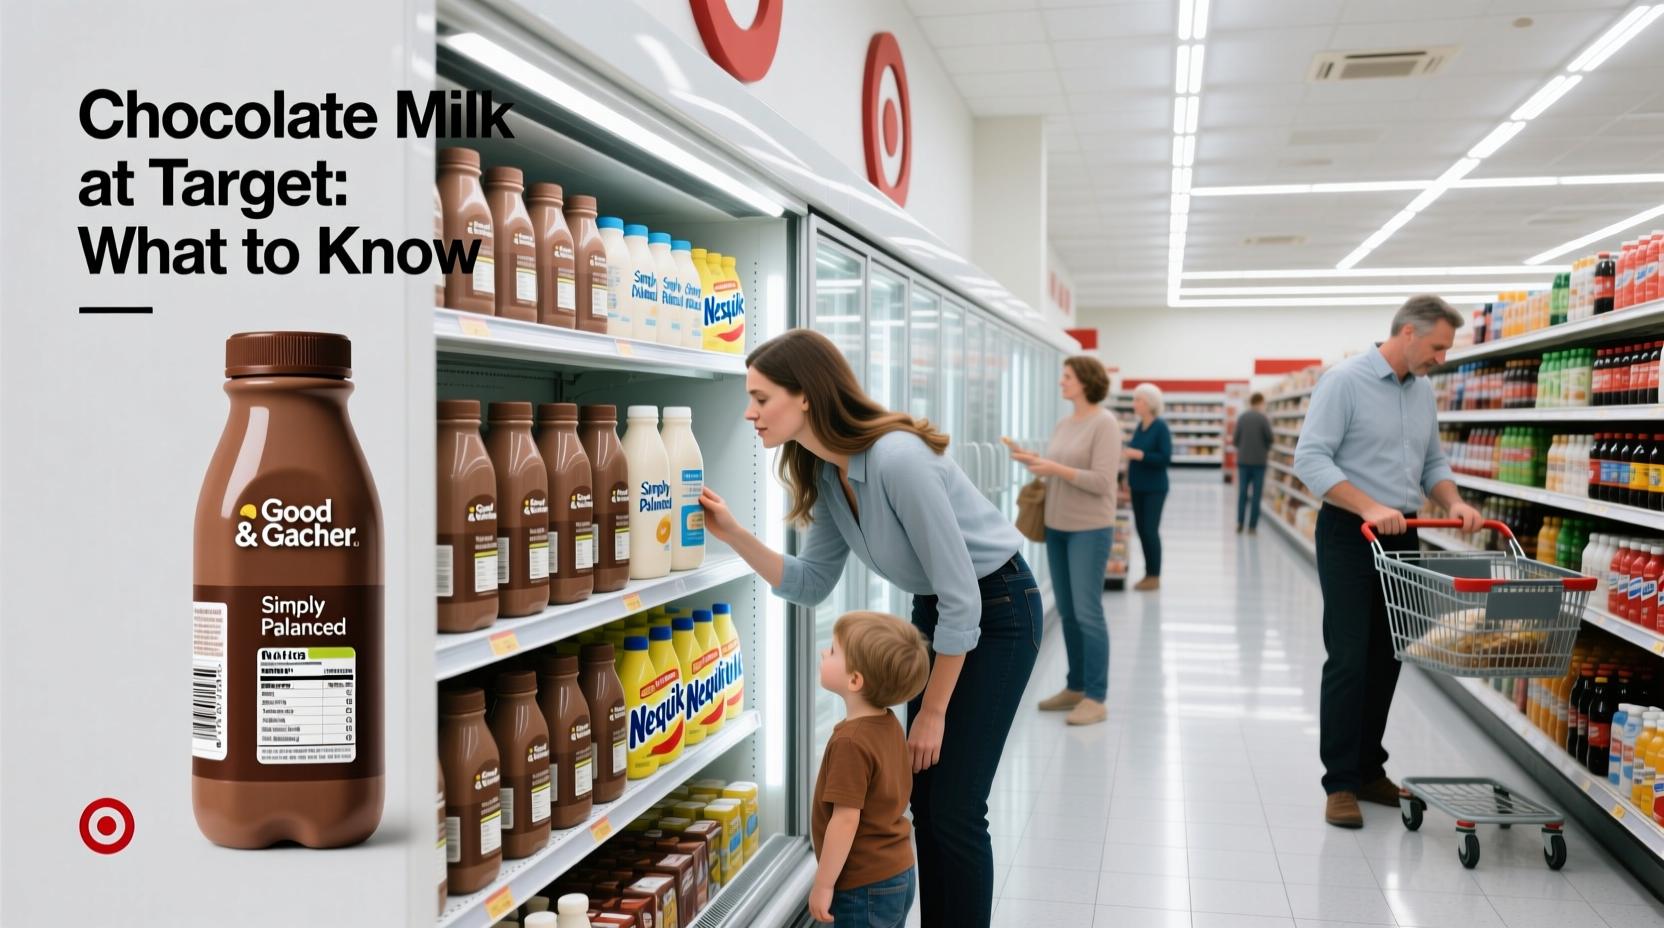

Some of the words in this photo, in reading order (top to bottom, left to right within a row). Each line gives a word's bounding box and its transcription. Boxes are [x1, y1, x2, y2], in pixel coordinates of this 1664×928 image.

[261, 498, 332, 523] Good
[235, 521, 258, 547] &
[261, 522, 356, 547] Gacher
[262, 595, 326, 619] Simply
[262, 616, 347, 637] Palanced
